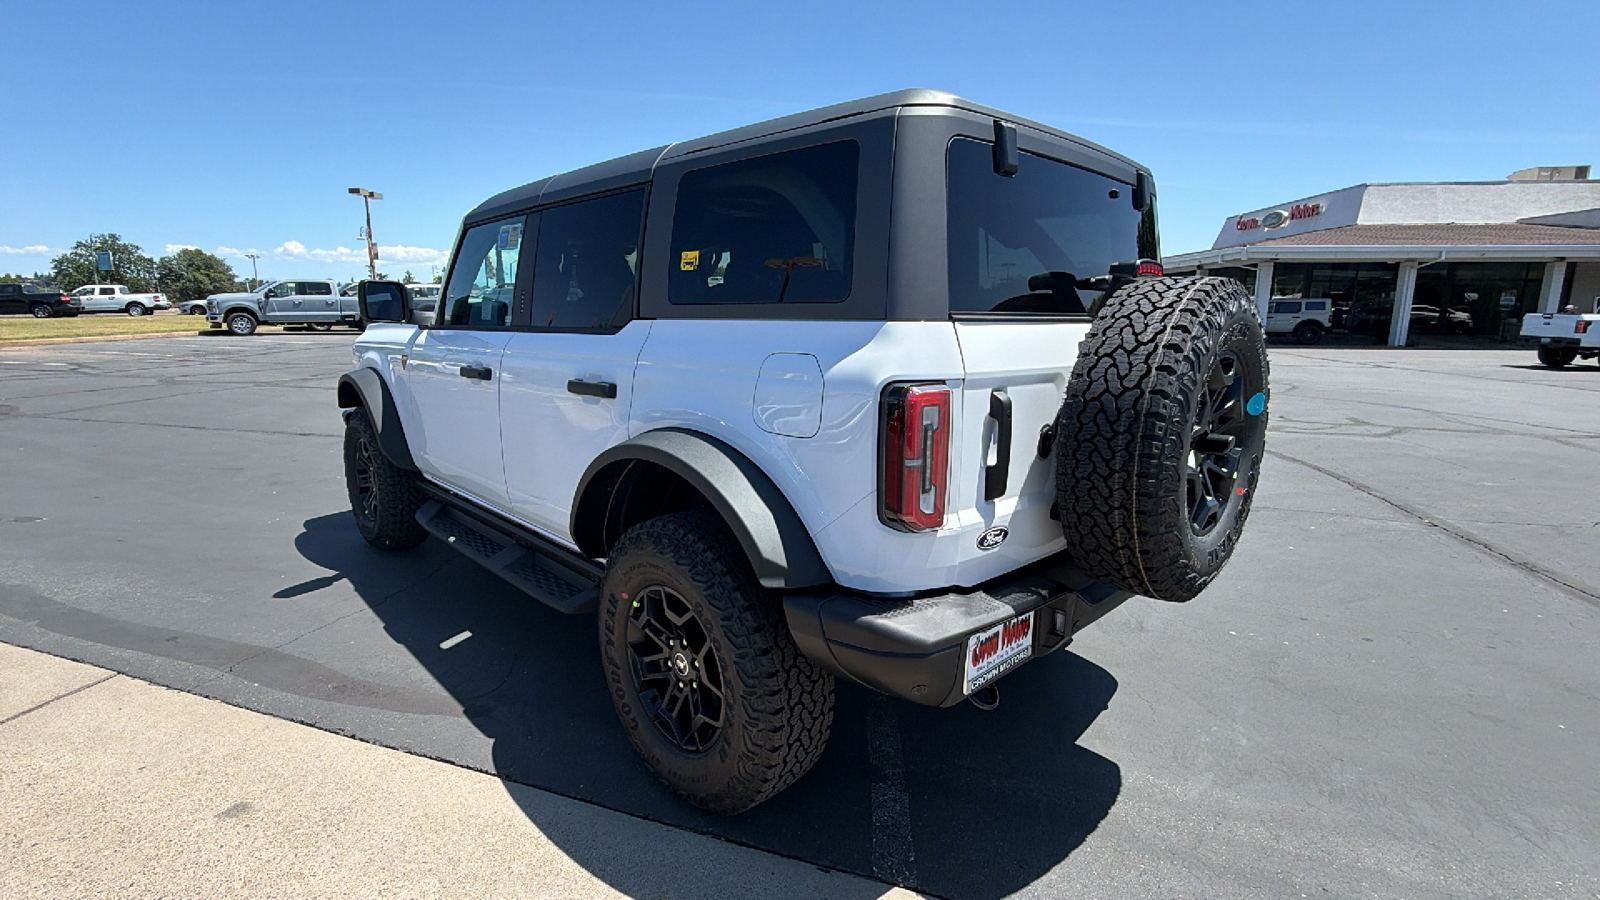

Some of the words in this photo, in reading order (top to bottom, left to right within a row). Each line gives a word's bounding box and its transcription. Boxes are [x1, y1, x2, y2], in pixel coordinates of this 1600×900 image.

[1290, 204, 1321, 221] Motors
[983, 530, 1005, 546] Ford
[971, 667, 999, 690] CROWN
[1000, 649, 1029, 673] MOTORS
